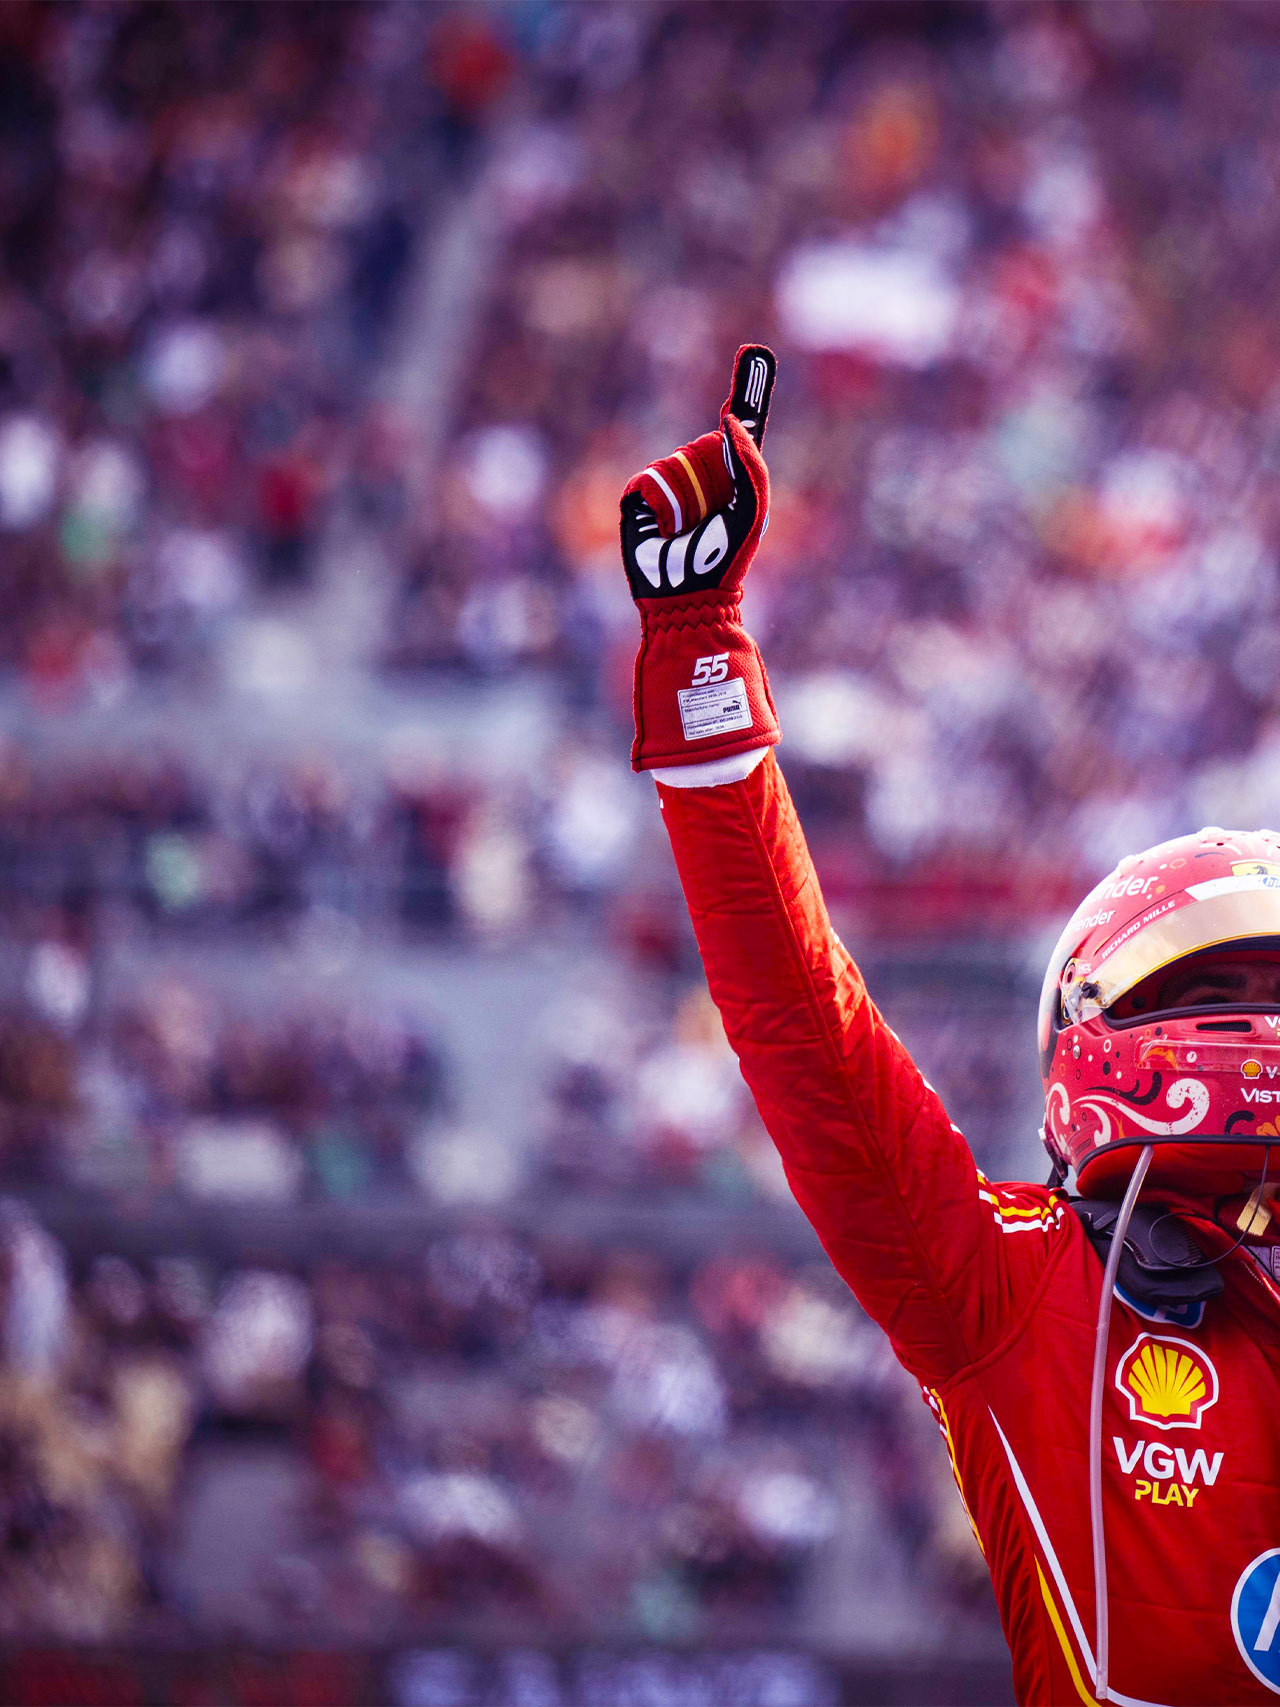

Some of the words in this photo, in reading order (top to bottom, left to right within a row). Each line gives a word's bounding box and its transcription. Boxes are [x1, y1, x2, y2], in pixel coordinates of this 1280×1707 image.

[691, 652, 730, 686] 55
[1101, 921, 1141, 960] RICHARD
[1142, 900, 1176, 924] MILLE
[1112, 1436, 1225, 1487] VGW
[1134, 1479, 1200, 1508] PLAY
